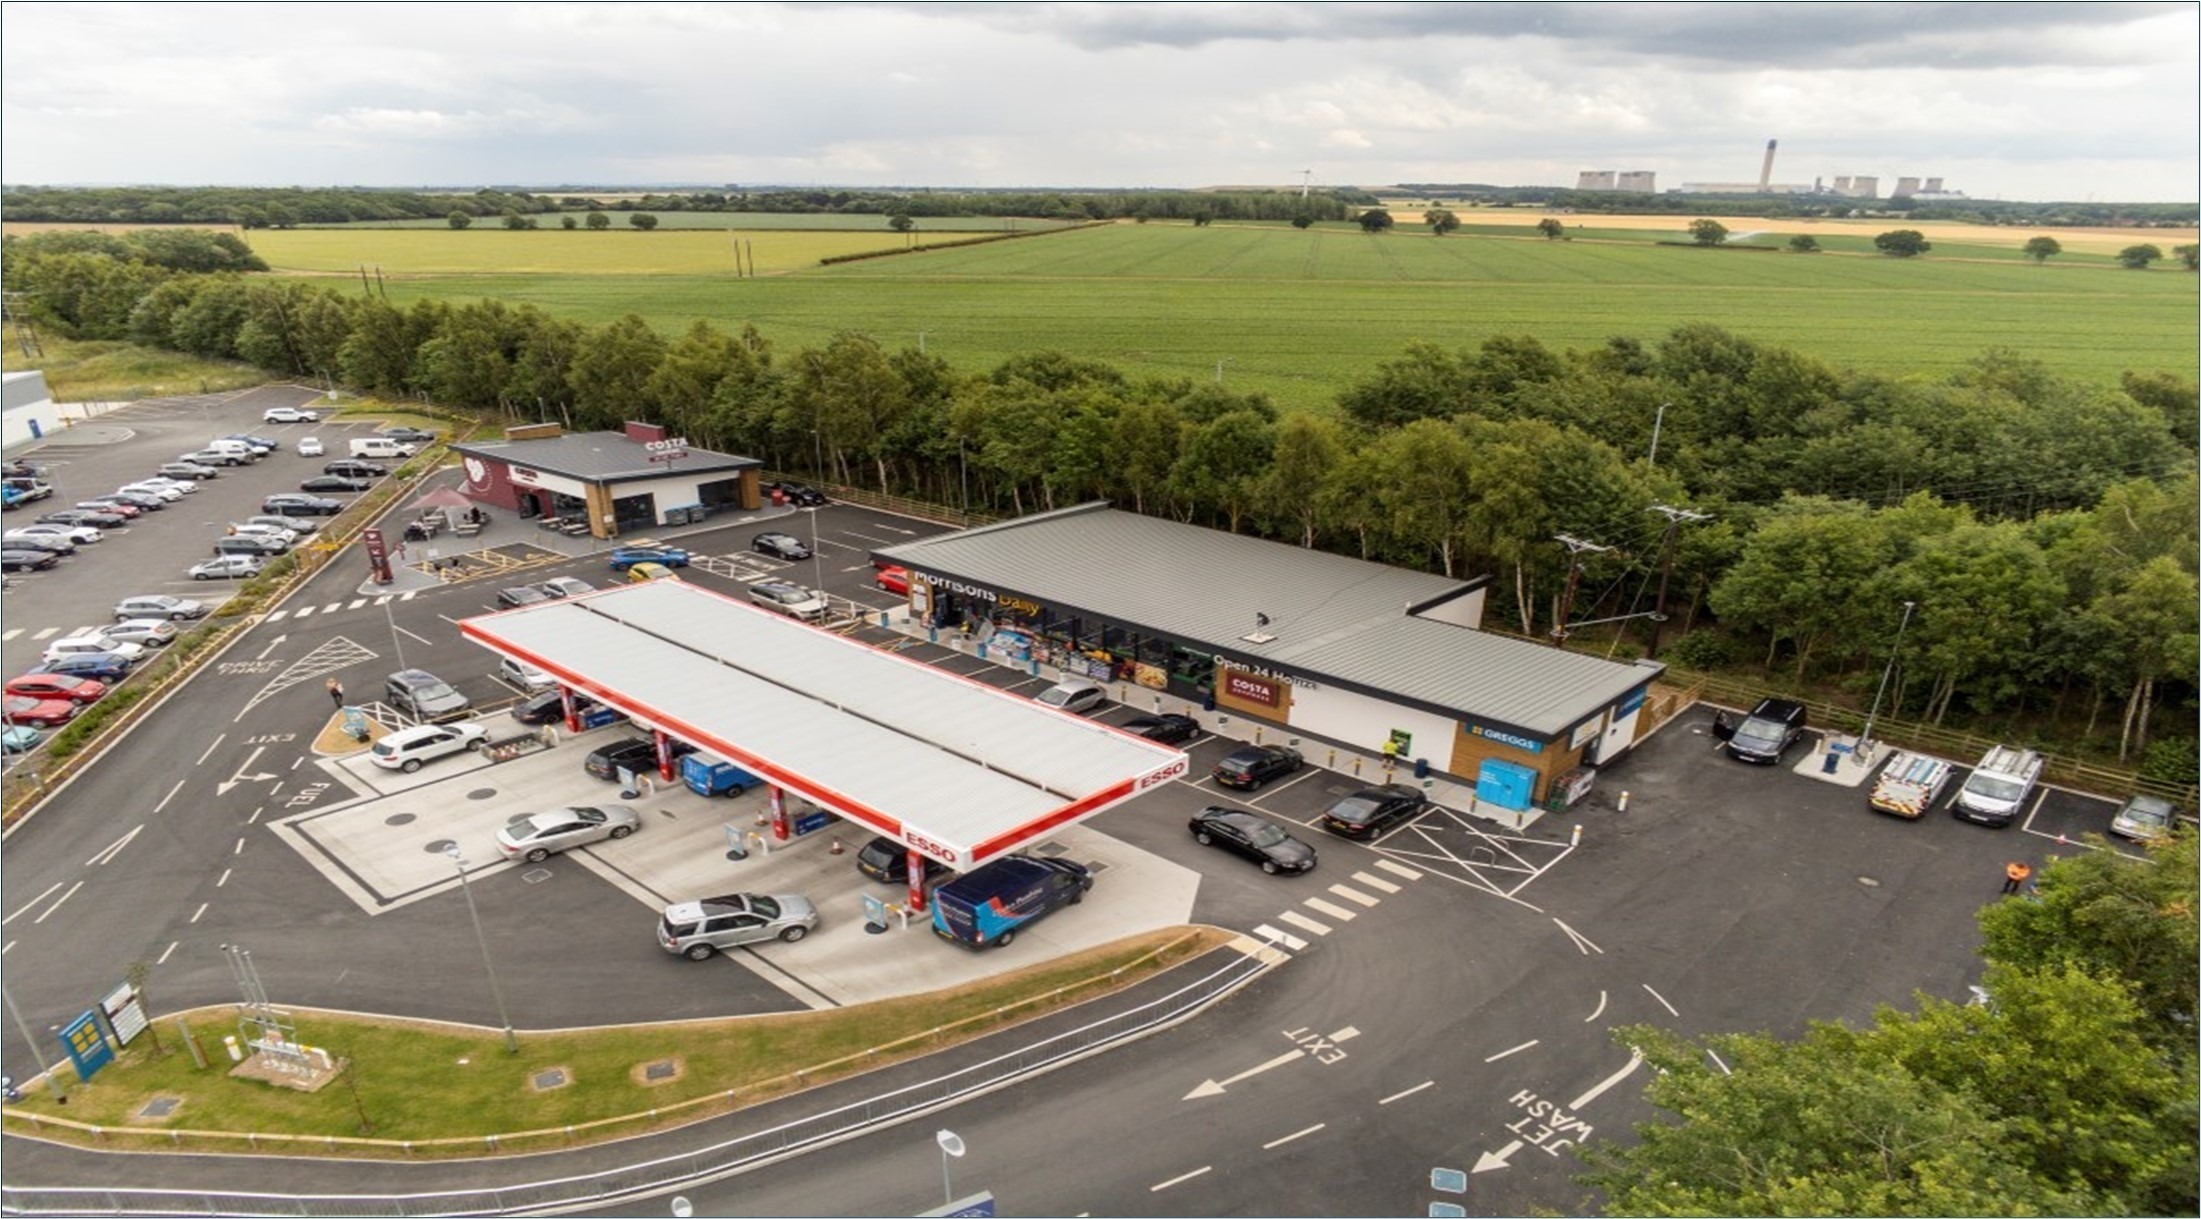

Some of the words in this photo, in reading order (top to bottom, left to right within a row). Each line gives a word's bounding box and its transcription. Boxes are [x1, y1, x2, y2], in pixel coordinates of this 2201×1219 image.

[645, 437, 688, 450] COSTA
[1213, 654, 1250, 673] Open
[1254, 665, 1270, 678] 24
[1232, 678, 1270, 696] COSTA
[242, 733, 296, 745] EXIT
[1484, 728, 1535, 750] GREGGS
[1141, 762, 1185, 789] ESSO
[284, 782, 332, 809] FUEL
[906, 832, 956, 863] ESSO
[1282, 1026, 1348, 1065] EXIT
[1508, 1088, 1594, 1143] WASH
[1505, 1117, 1574, 1157] JET
